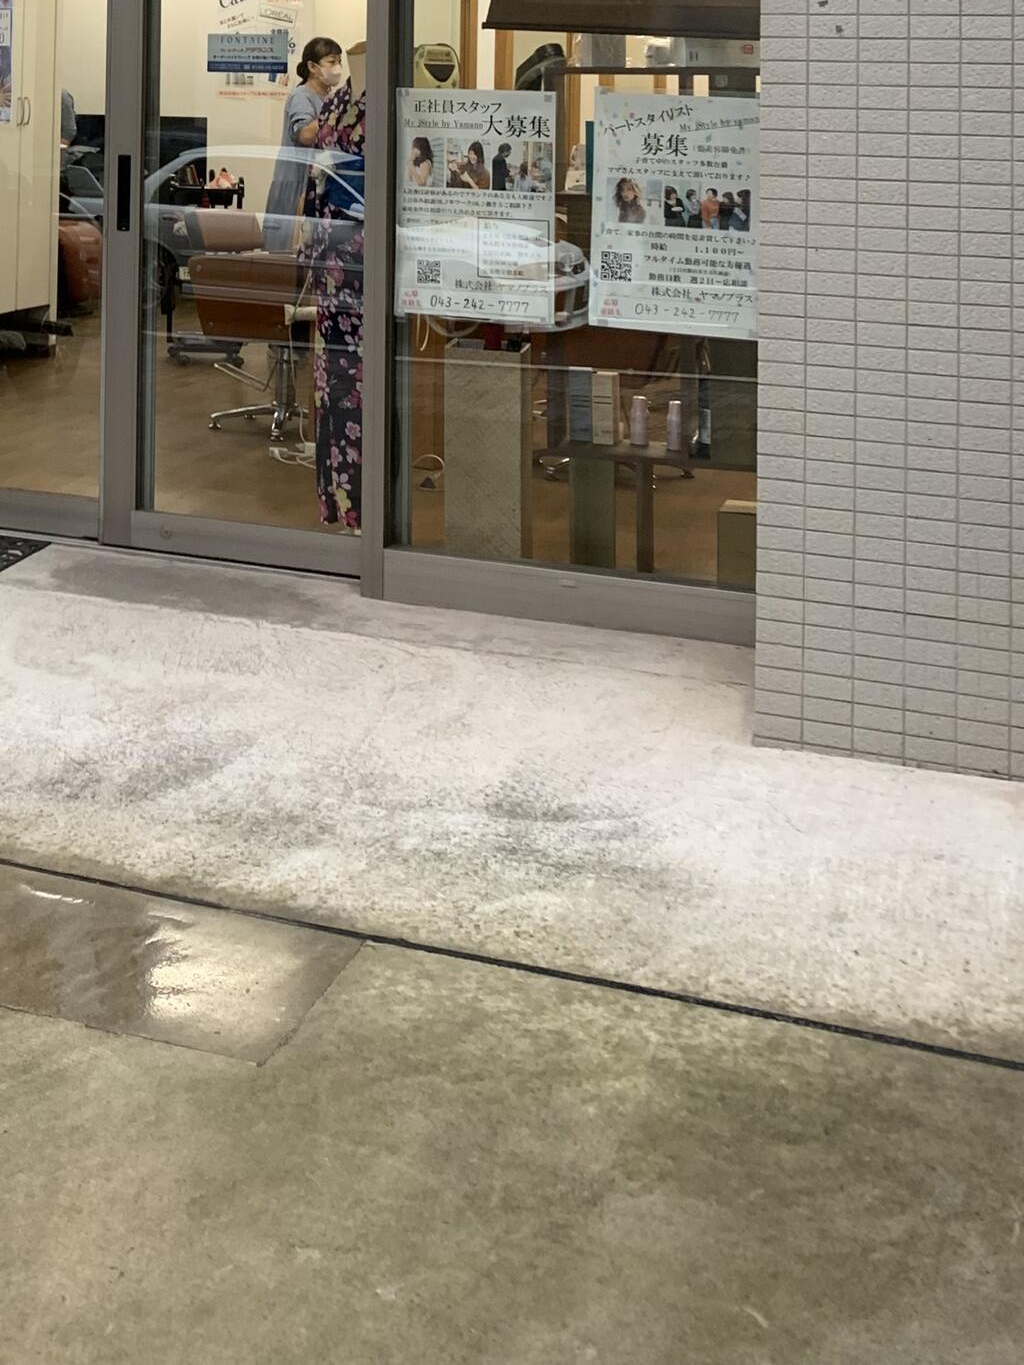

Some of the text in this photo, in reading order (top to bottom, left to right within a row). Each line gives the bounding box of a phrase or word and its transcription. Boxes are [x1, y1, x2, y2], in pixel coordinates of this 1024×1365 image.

[220, 36, 275, 45] FONTAINE
[414, 99, 502, 115] 正社員スタッフ
[481, 115, 551, 138] 大募集
[604, 104, 694, 135] パートスタイリスト
[641, 133, 689, 156] 募集
[651, 286, 692, 299] 株式会社
